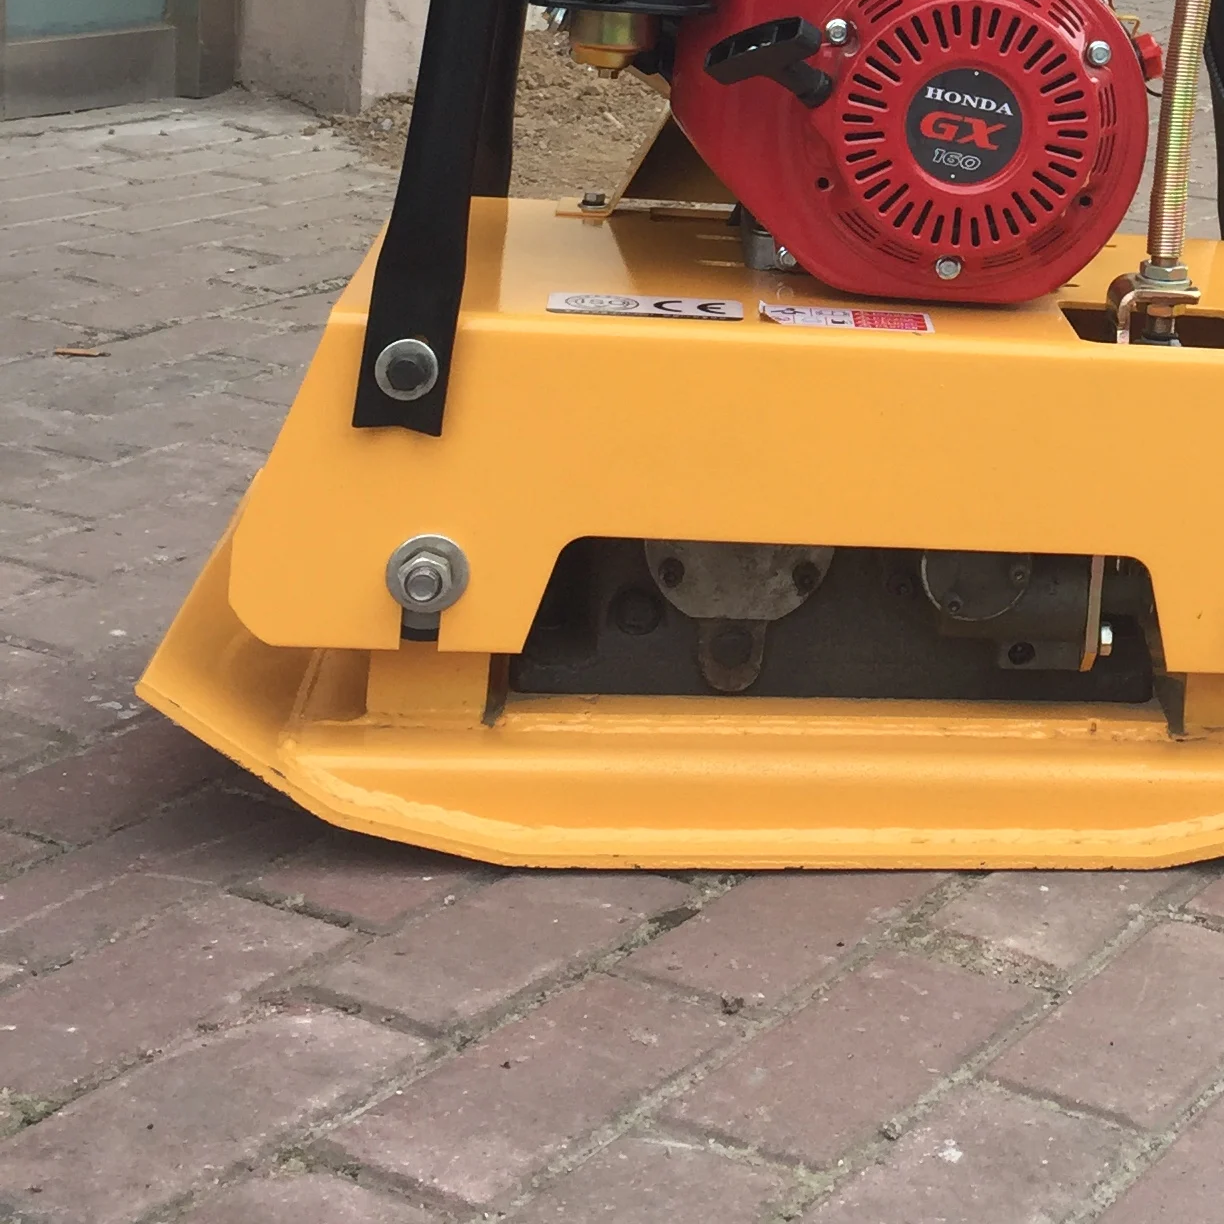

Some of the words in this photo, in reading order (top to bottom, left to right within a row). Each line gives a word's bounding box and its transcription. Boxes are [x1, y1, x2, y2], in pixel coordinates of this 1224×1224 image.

[924, 86, 1014, 116] HONDA
[919, 110, 1007, 151] GX
[932, 147, 981, 171] 160
[652, 300, 726, 315] CE
